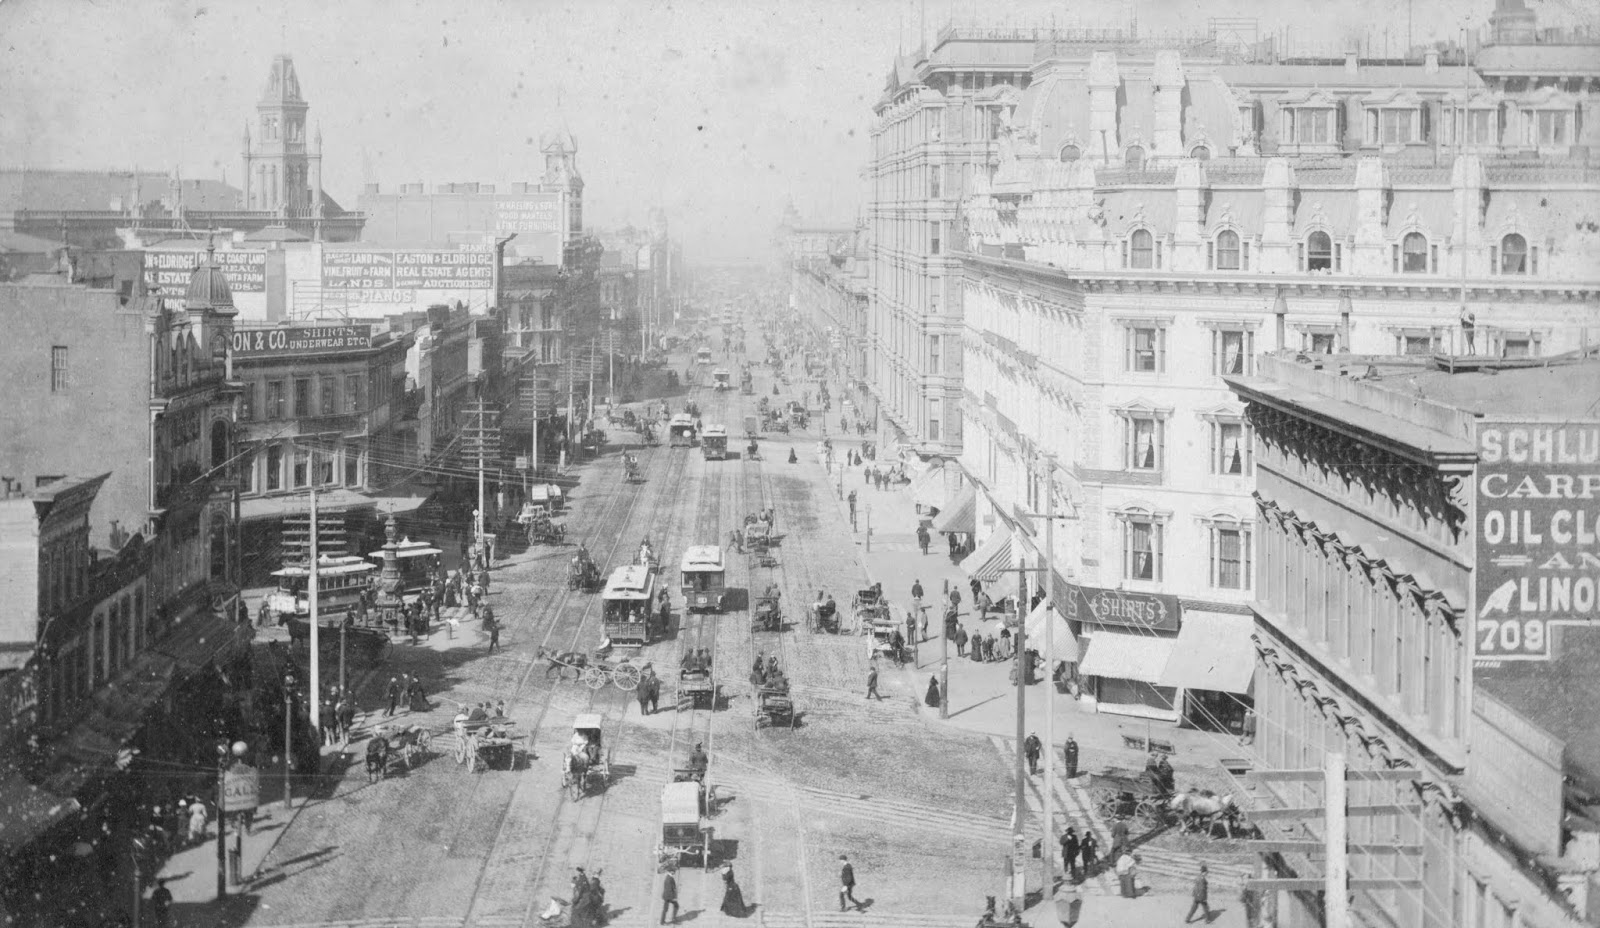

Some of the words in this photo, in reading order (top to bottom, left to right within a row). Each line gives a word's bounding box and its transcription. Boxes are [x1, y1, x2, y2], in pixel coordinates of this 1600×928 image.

[227, 254, 250, 264] COAST
[249, 254, 265, 264] LAND
[351, 253, 372, 264] LAND
[396, 253, 434, 264] EASTON
[434, 255, 441, 263] &
[370, 266, 391, 277] FARM
[396, 266, 419, 277] REAL
[421, 266, 453, 277] ESTATE
[456, 267, 491, 277] AGENTS
[158, 272, 191, 284] ESTATE
[243, 274, 263, 282] FARM
[255, 331, 264, 350] &
[269, 330, 288, 349] CO.
[289, 338, 344, 349] UNDERWEAR
[1482, 429, 1598, 463] SCHLU
[1484, 509, 1542, 544] OIL
[1551, 509, 1600, 544] CL
[1520, 577, 1600, 613] LINO
[1101, 597, 1155, 620] SHIRTS
[1478, 619, 1544, 651] 709
